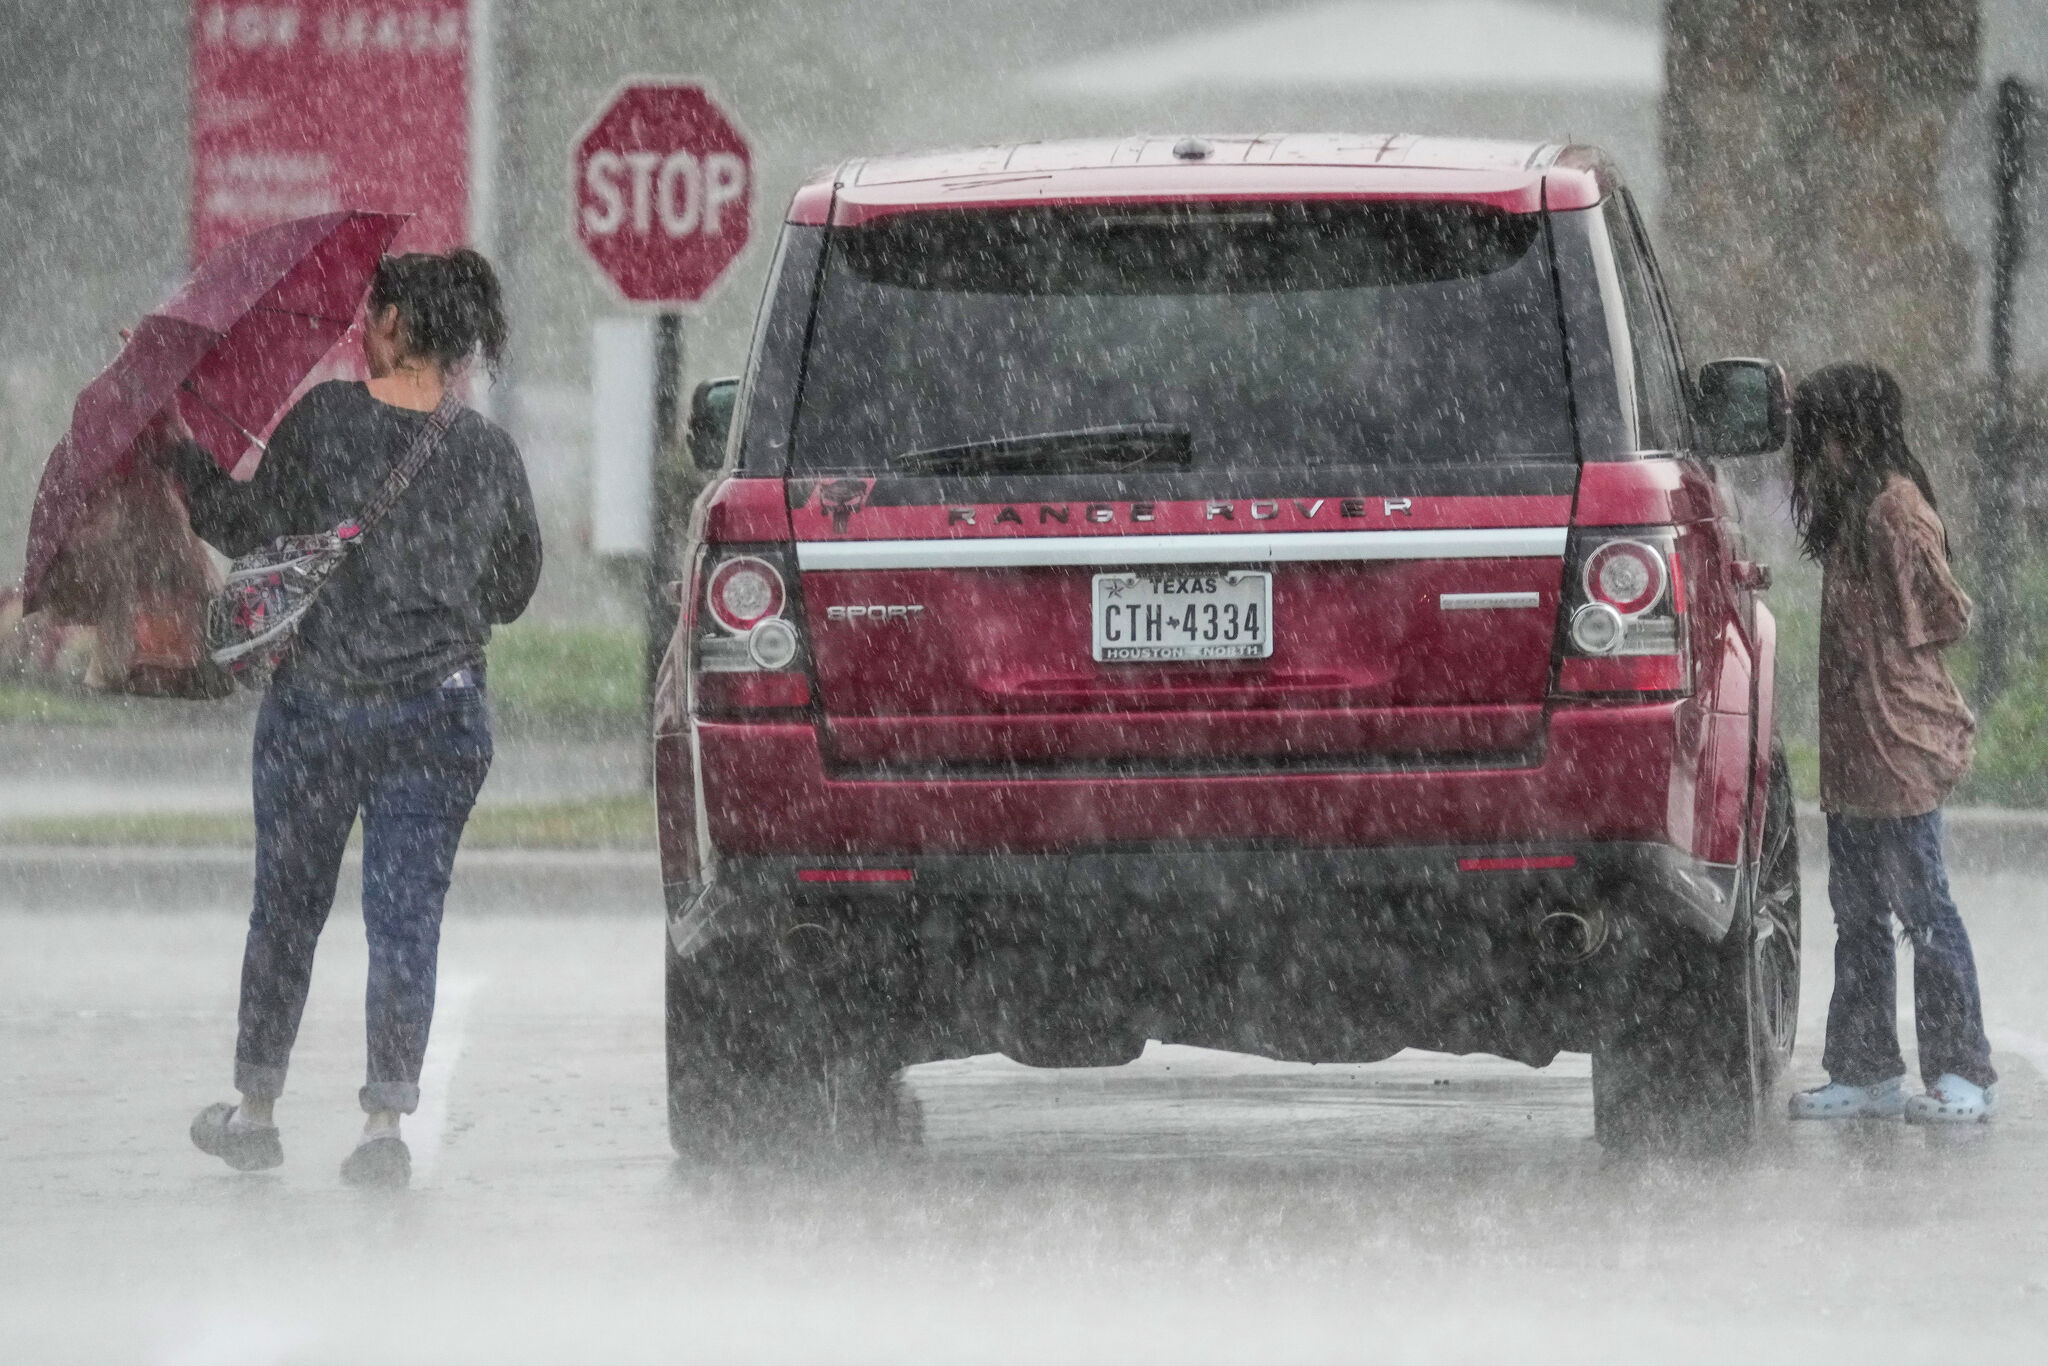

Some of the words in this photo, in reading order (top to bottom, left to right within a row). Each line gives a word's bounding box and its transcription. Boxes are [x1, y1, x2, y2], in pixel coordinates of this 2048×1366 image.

[584, 151, 746, 237] STOP
[949, 504, 1155, 526] RANGE
[1206, 498, 1412, 521] ROVER
[1150, 577, 1217, 594] TEXAS
[827, 604, 925, 622] SPORT
[1107, 648, 1183, 659] HOUSTON
[1204, 646, 1258, 657] NORTH
